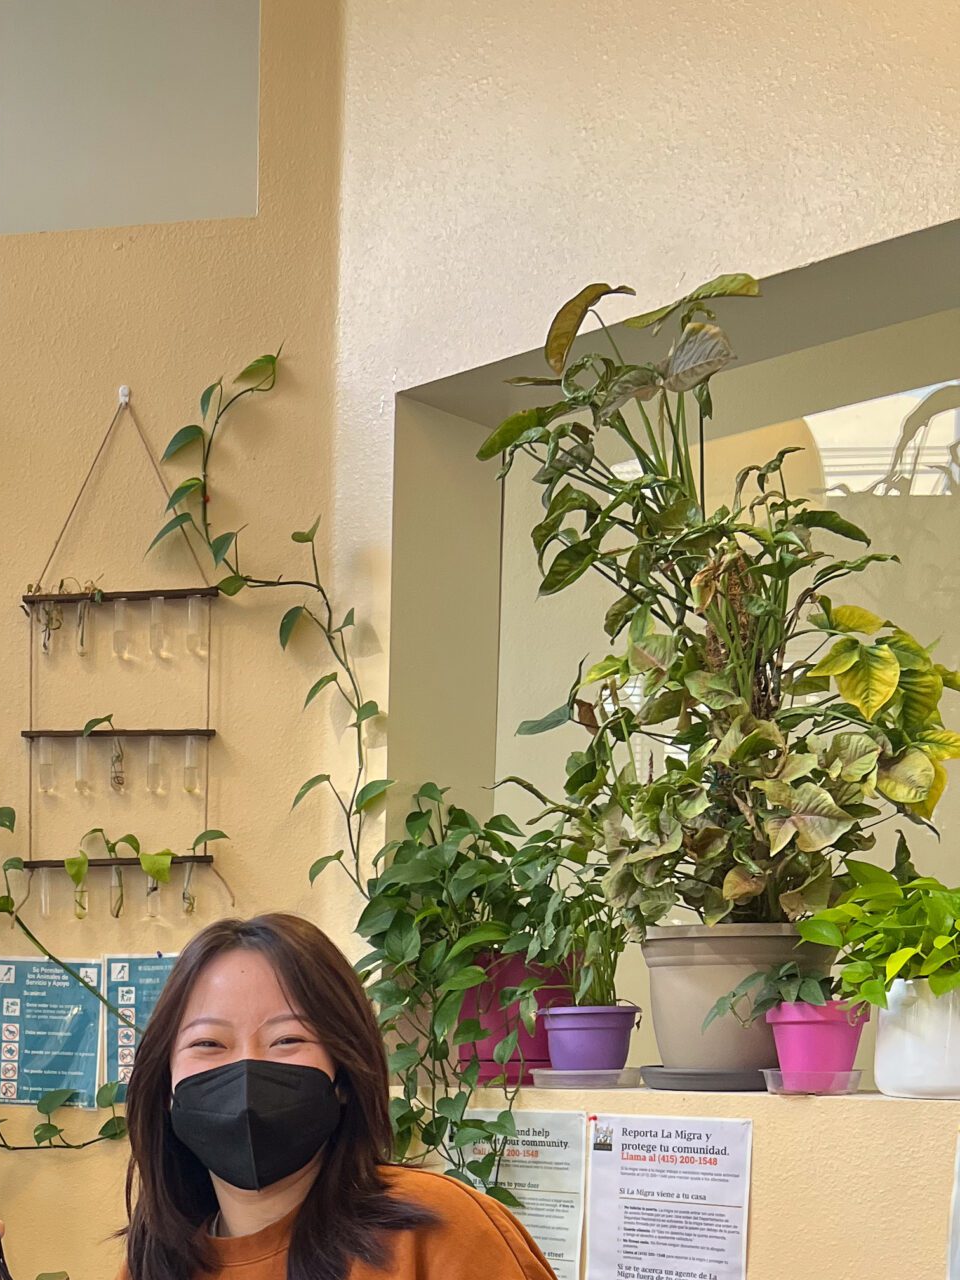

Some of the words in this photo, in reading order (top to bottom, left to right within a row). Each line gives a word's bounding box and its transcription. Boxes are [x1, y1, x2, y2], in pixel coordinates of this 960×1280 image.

[532, 1128, 550, 1138] help
[621, 1127, 658, 1139] Reporta
[661, 1129, 672, 1139] La
[675, 1130, 702, 1141] Migra
[705, 1132, 712, 1143] y
[521, 1139, 570, 1150] community.
[621, 1141, 657, 1153] protege
[659, 1144, 670, 1153] tu
[672, 1144, 730, 1156] comunidad.
[621, 1152, 647, 1162] Llama
[648, 1153, 656, 1162] al
[658, 1154, 678, 1165] (415)
[680, 1156, 718, 1166] 200-1548
[636, 1189, 654, 1197] Migra
[657, 1190, 675, 1198] viene
[547, 1251, 564, 1259] street
[617, 1270, 635, 1280] Migra
[655, 1273, 664, 1280] de
[641, 1267, 662, 1275] acerca
[675, 1270, 697, 1279] agente
[709, 1273, 717, 1280] La
